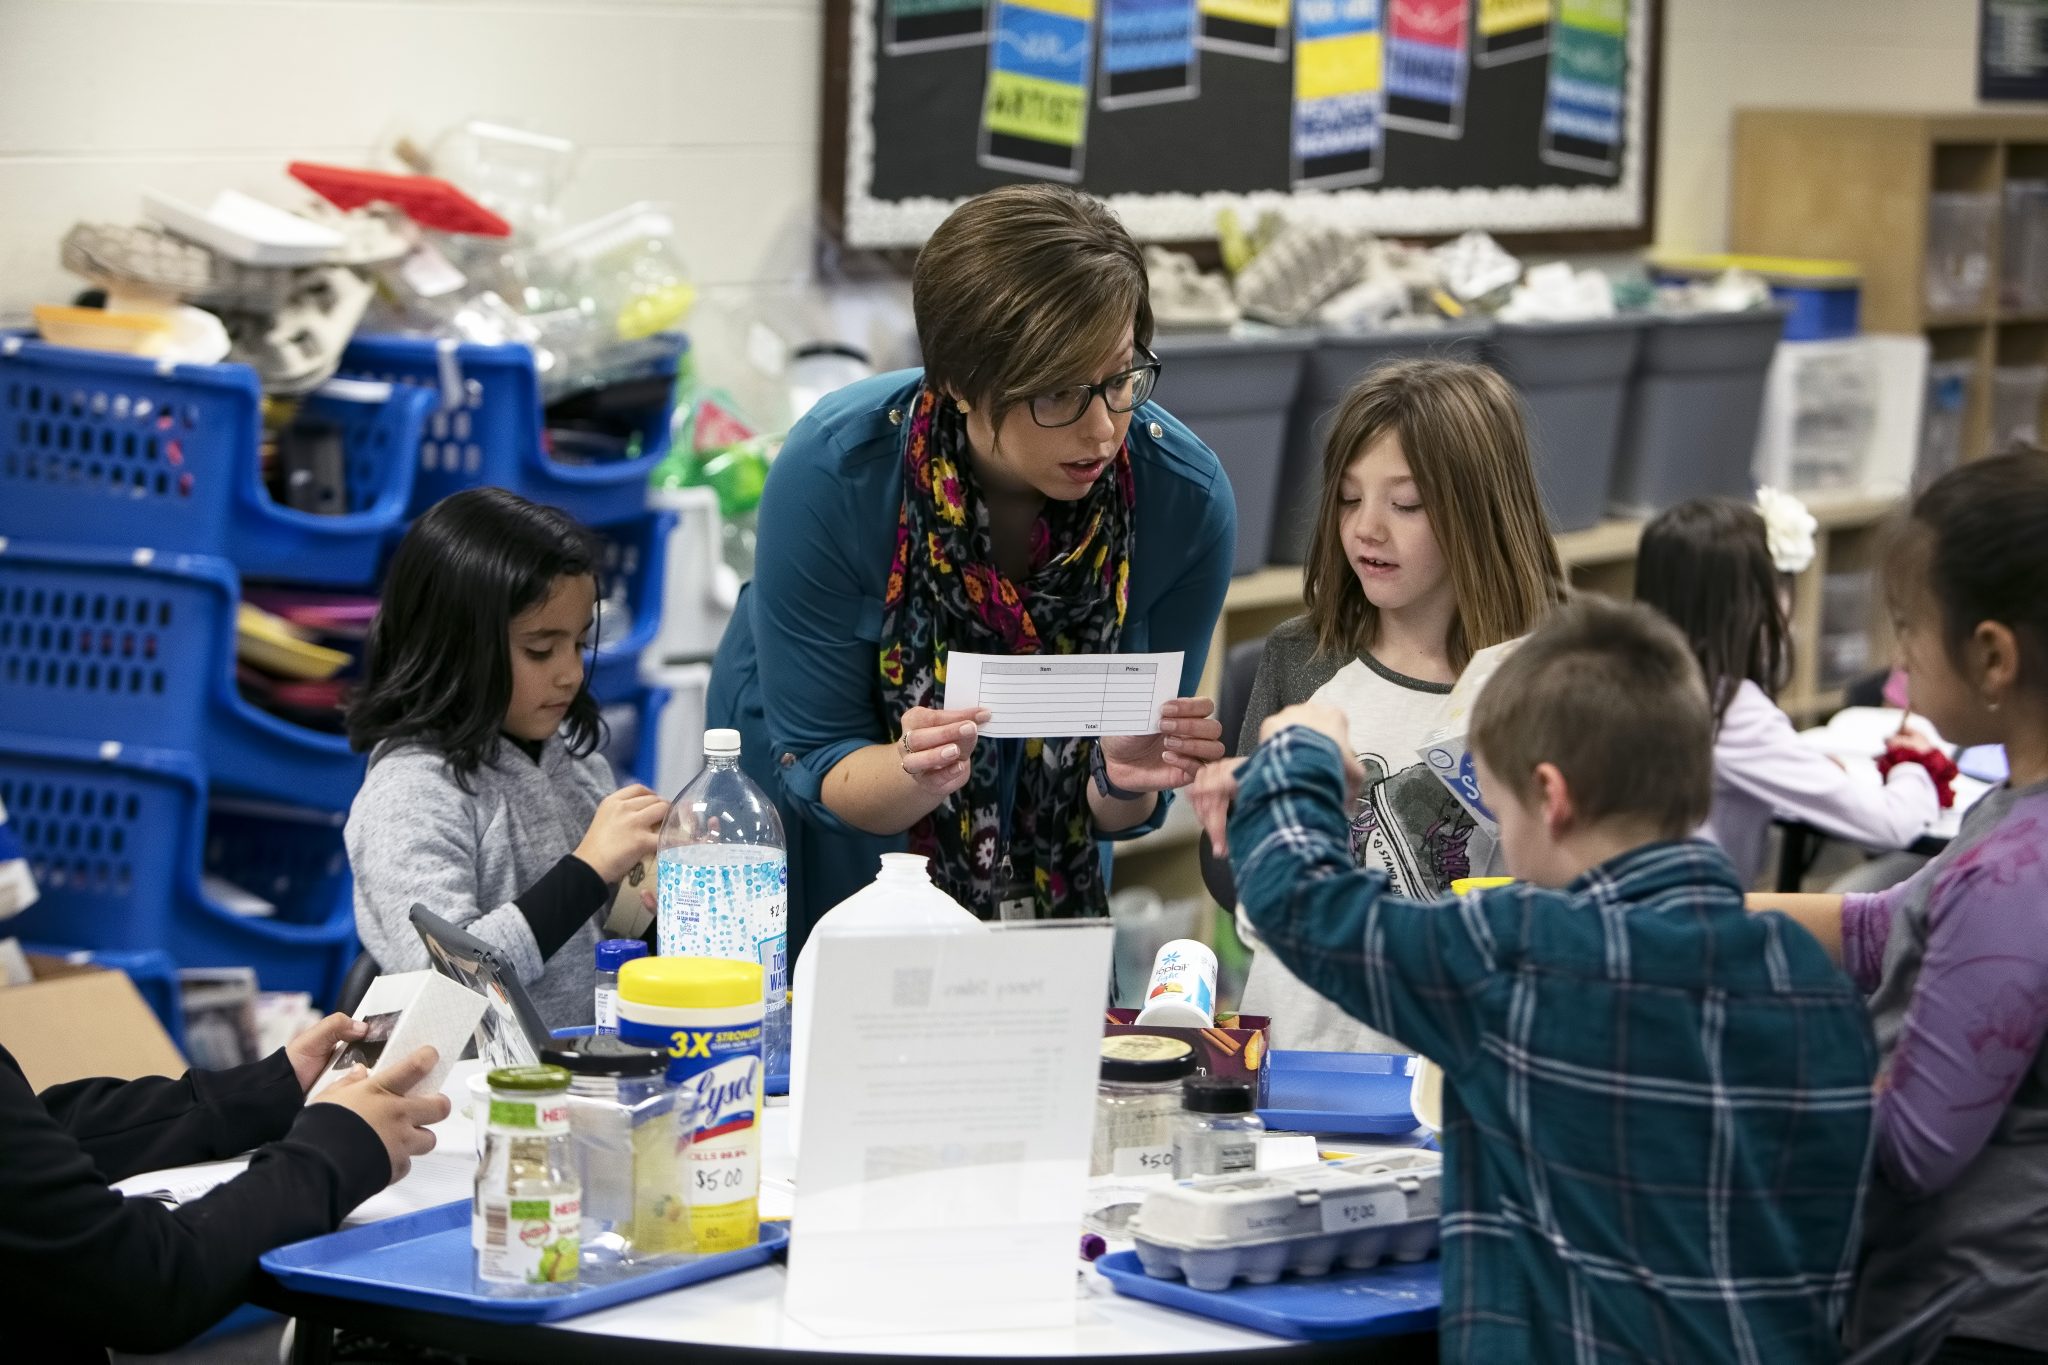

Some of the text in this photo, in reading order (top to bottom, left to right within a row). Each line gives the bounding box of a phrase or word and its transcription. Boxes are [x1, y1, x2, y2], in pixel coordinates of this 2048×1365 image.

[987, 85, 1081, 128] ARTIST
[1379, 850, 1398, 880] STAND
[667, 1031, 714, 1058] 3X
[679, 1059, 757, 1126] Lysol
